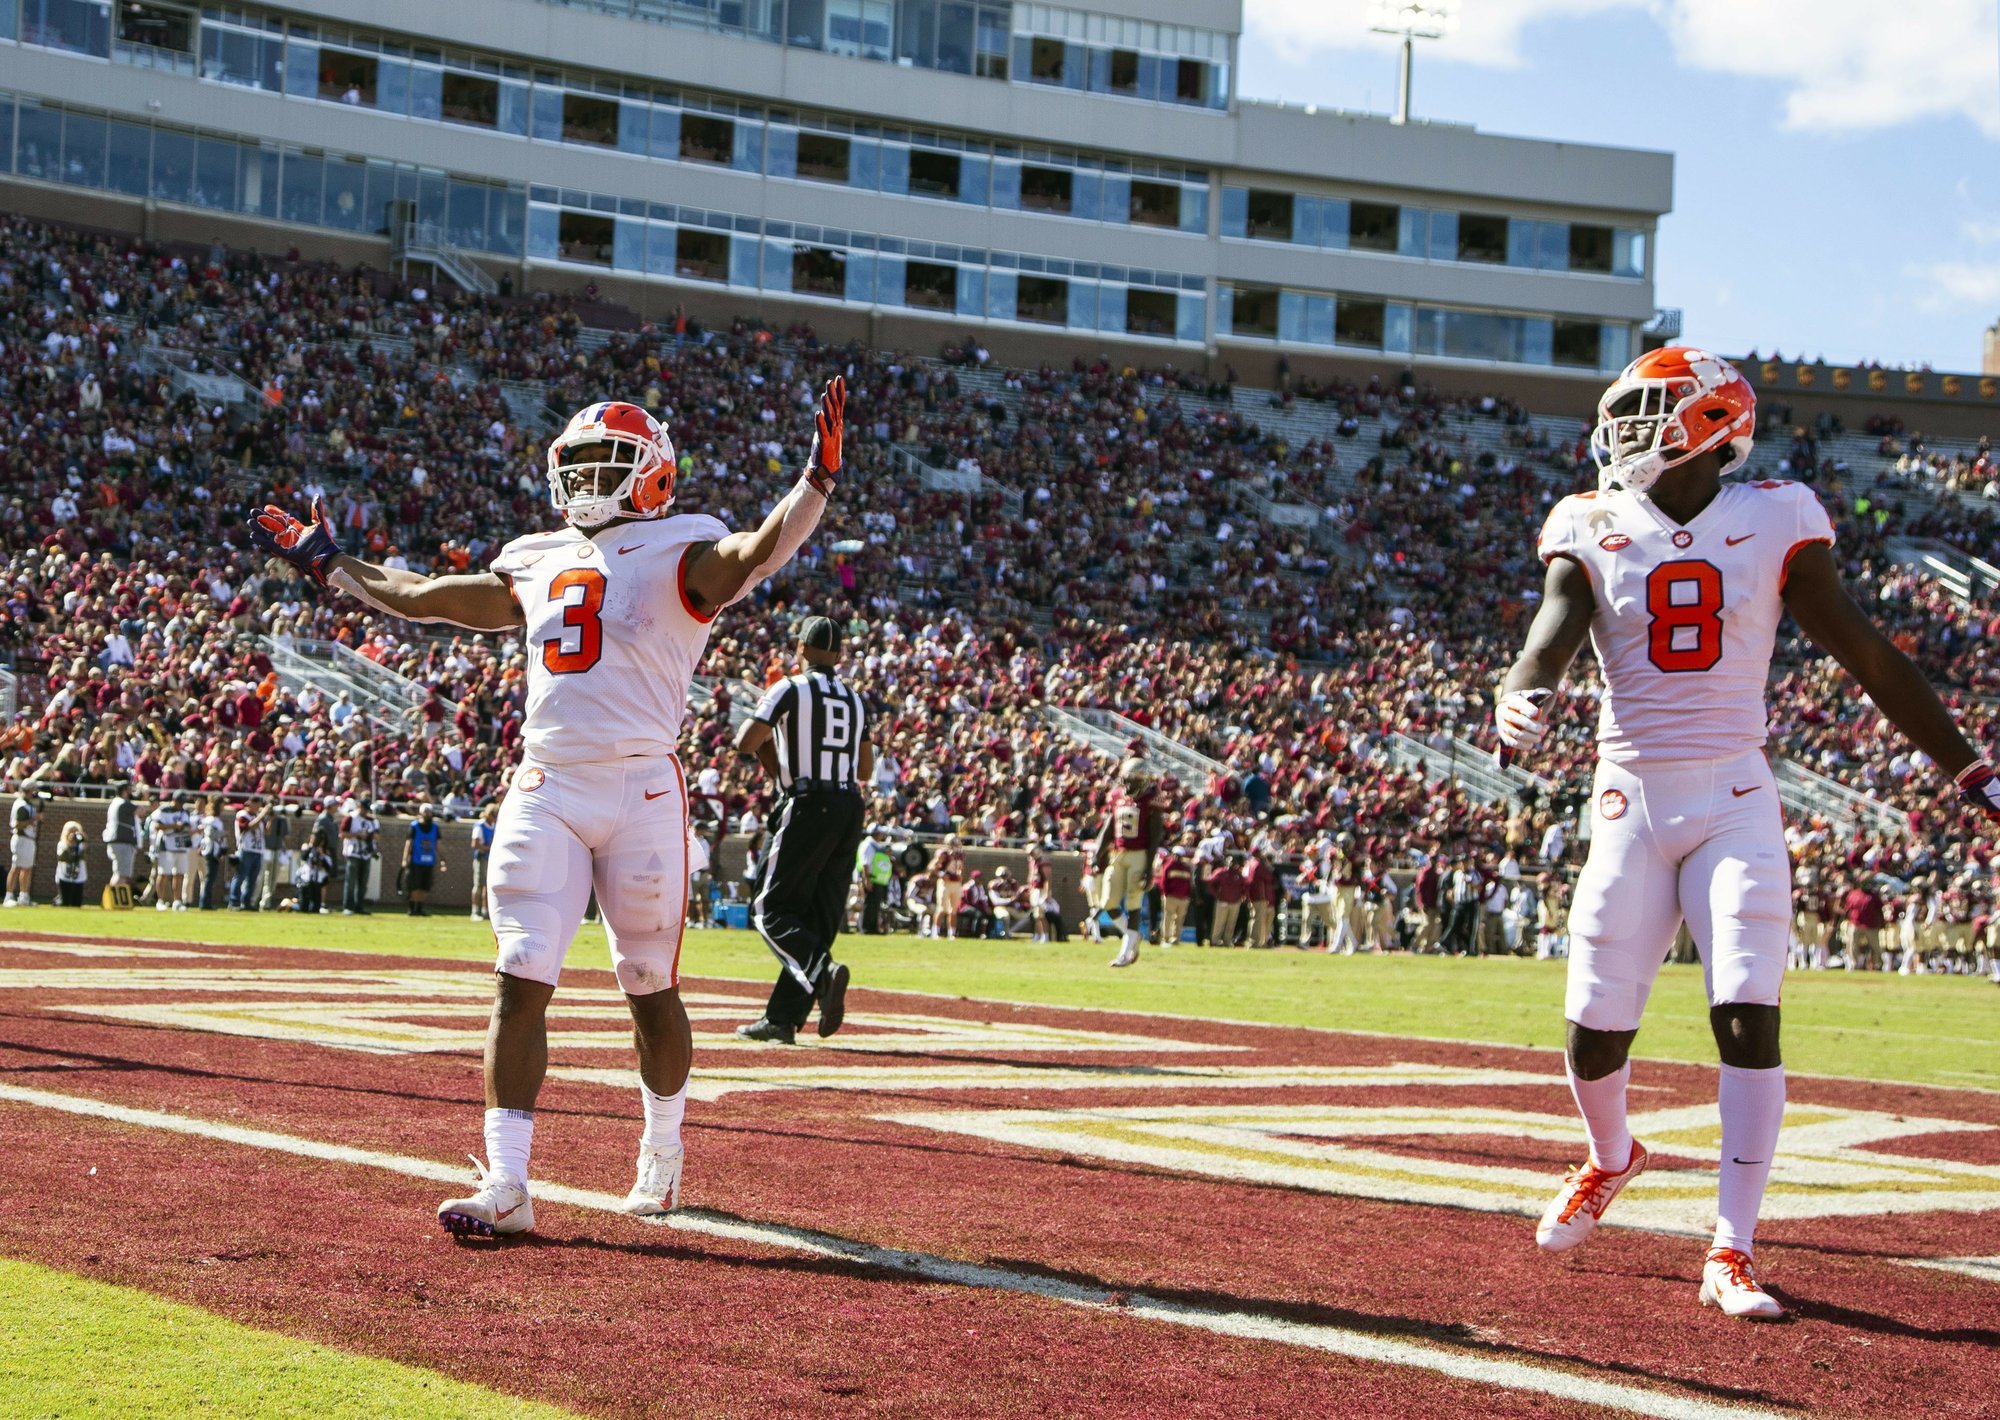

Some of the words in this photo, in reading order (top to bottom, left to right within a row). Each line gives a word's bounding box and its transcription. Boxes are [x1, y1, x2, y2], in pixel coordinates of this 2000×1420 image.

[1602, 535, 1628, 546] ACC
[542, 567, 608, 675] 3
[1646, 558, 1724, 674] 8
[822, 696, 851, 748] B
[110, 885, 131, 906] 10
